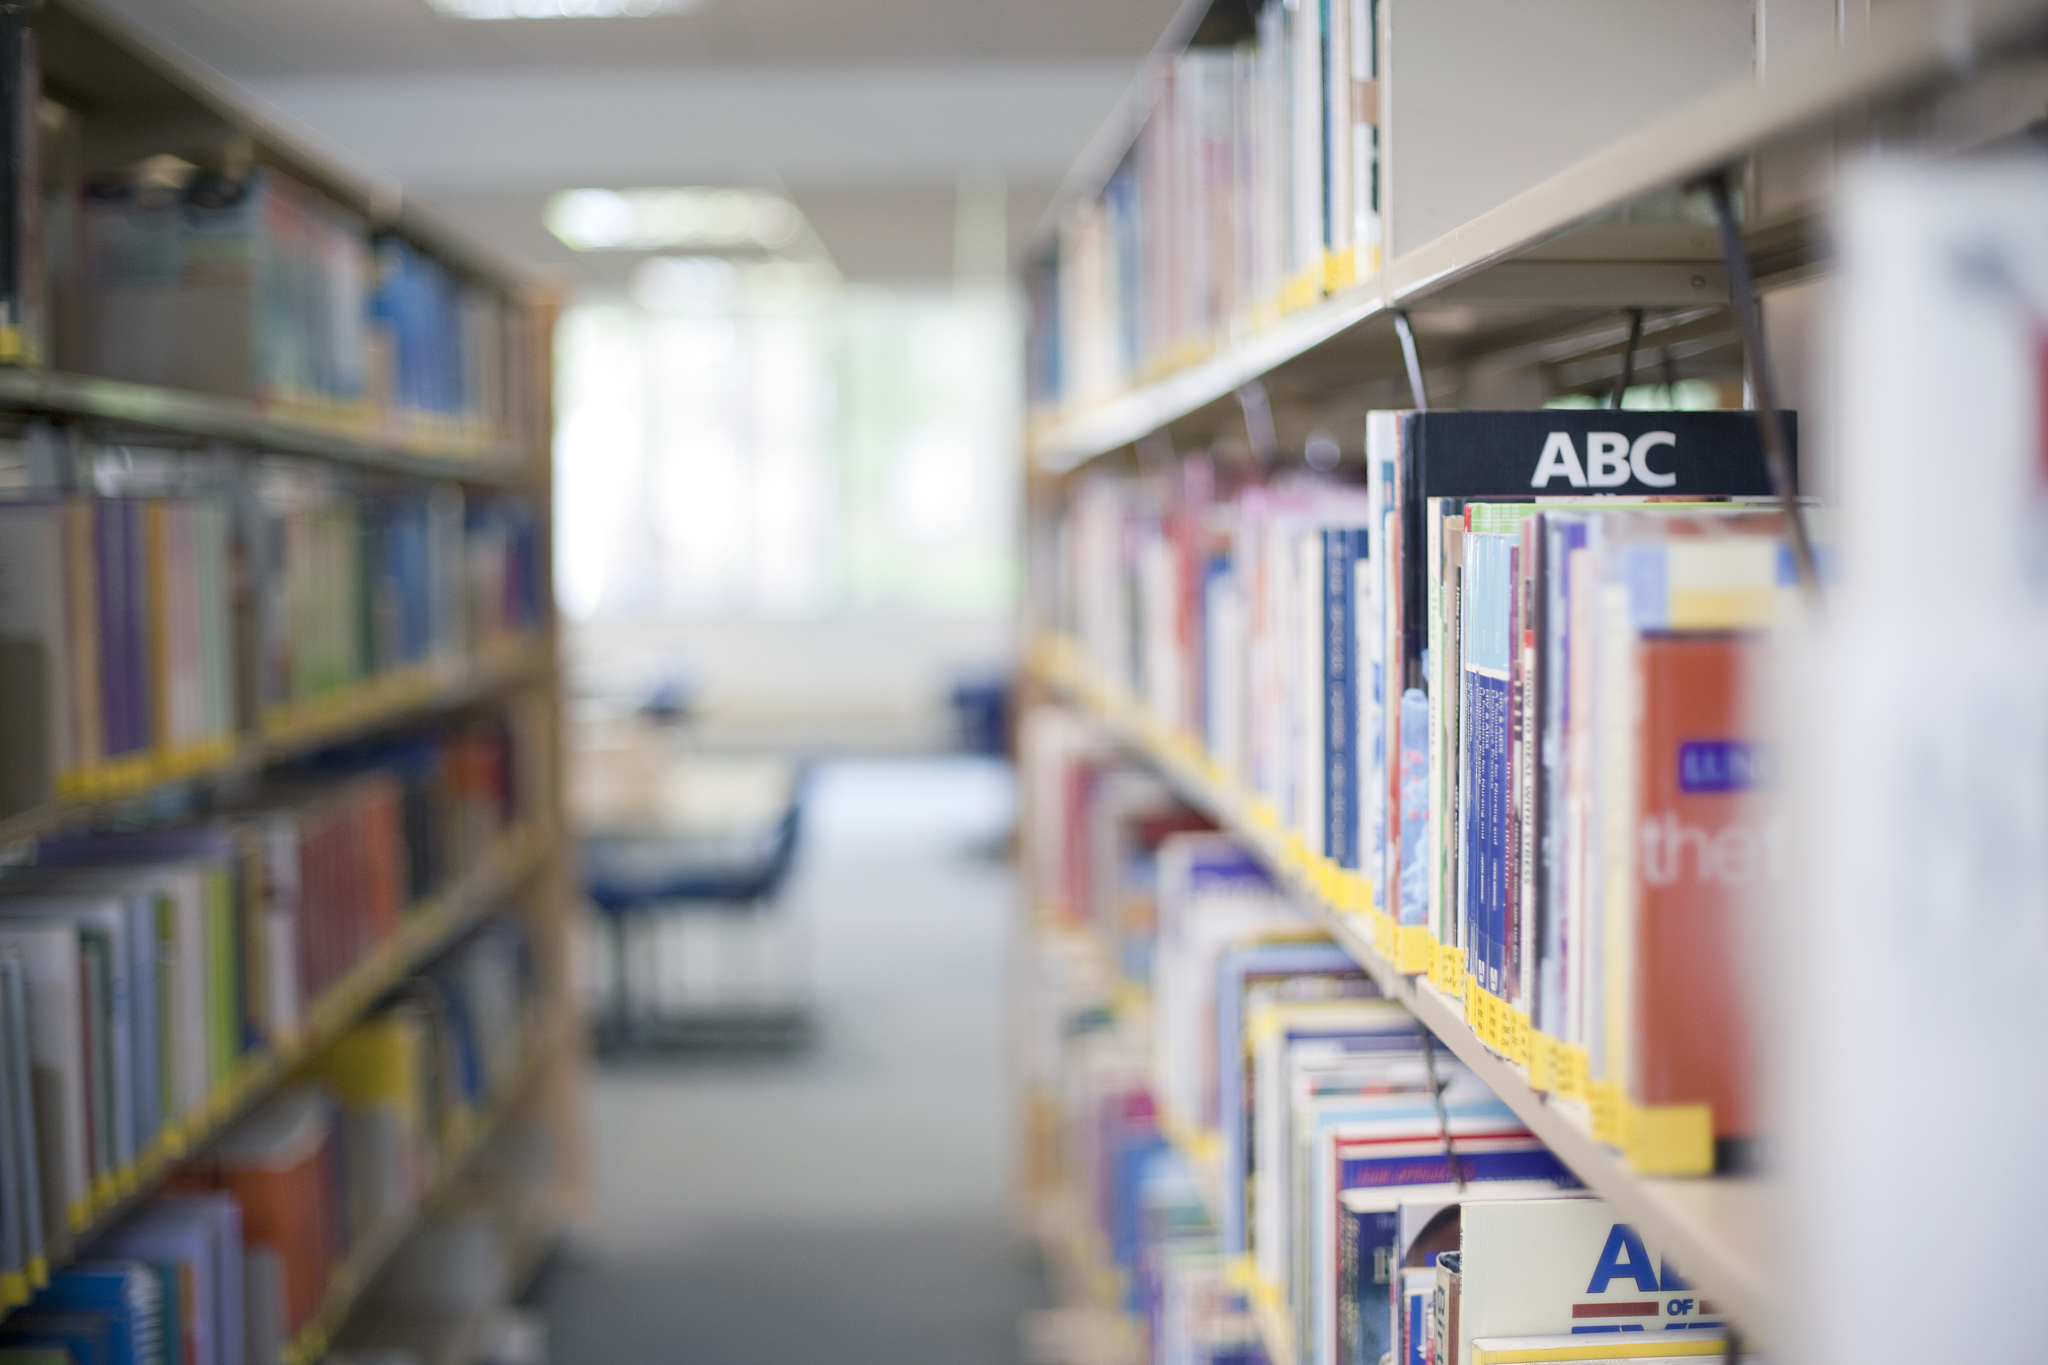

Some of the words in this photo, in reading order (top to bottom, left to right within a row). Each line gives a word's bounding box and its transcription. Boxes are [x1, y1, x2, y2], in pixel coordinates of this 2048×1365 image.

[1530, 430, 1677, 488] ABC
[1430, 573, 1438, 685] Allergy
[1525, 670, 1533, 708] HOW
[1525, 716, 1533, 734] TO
[1666, 1297, 1694, 1317] OF
